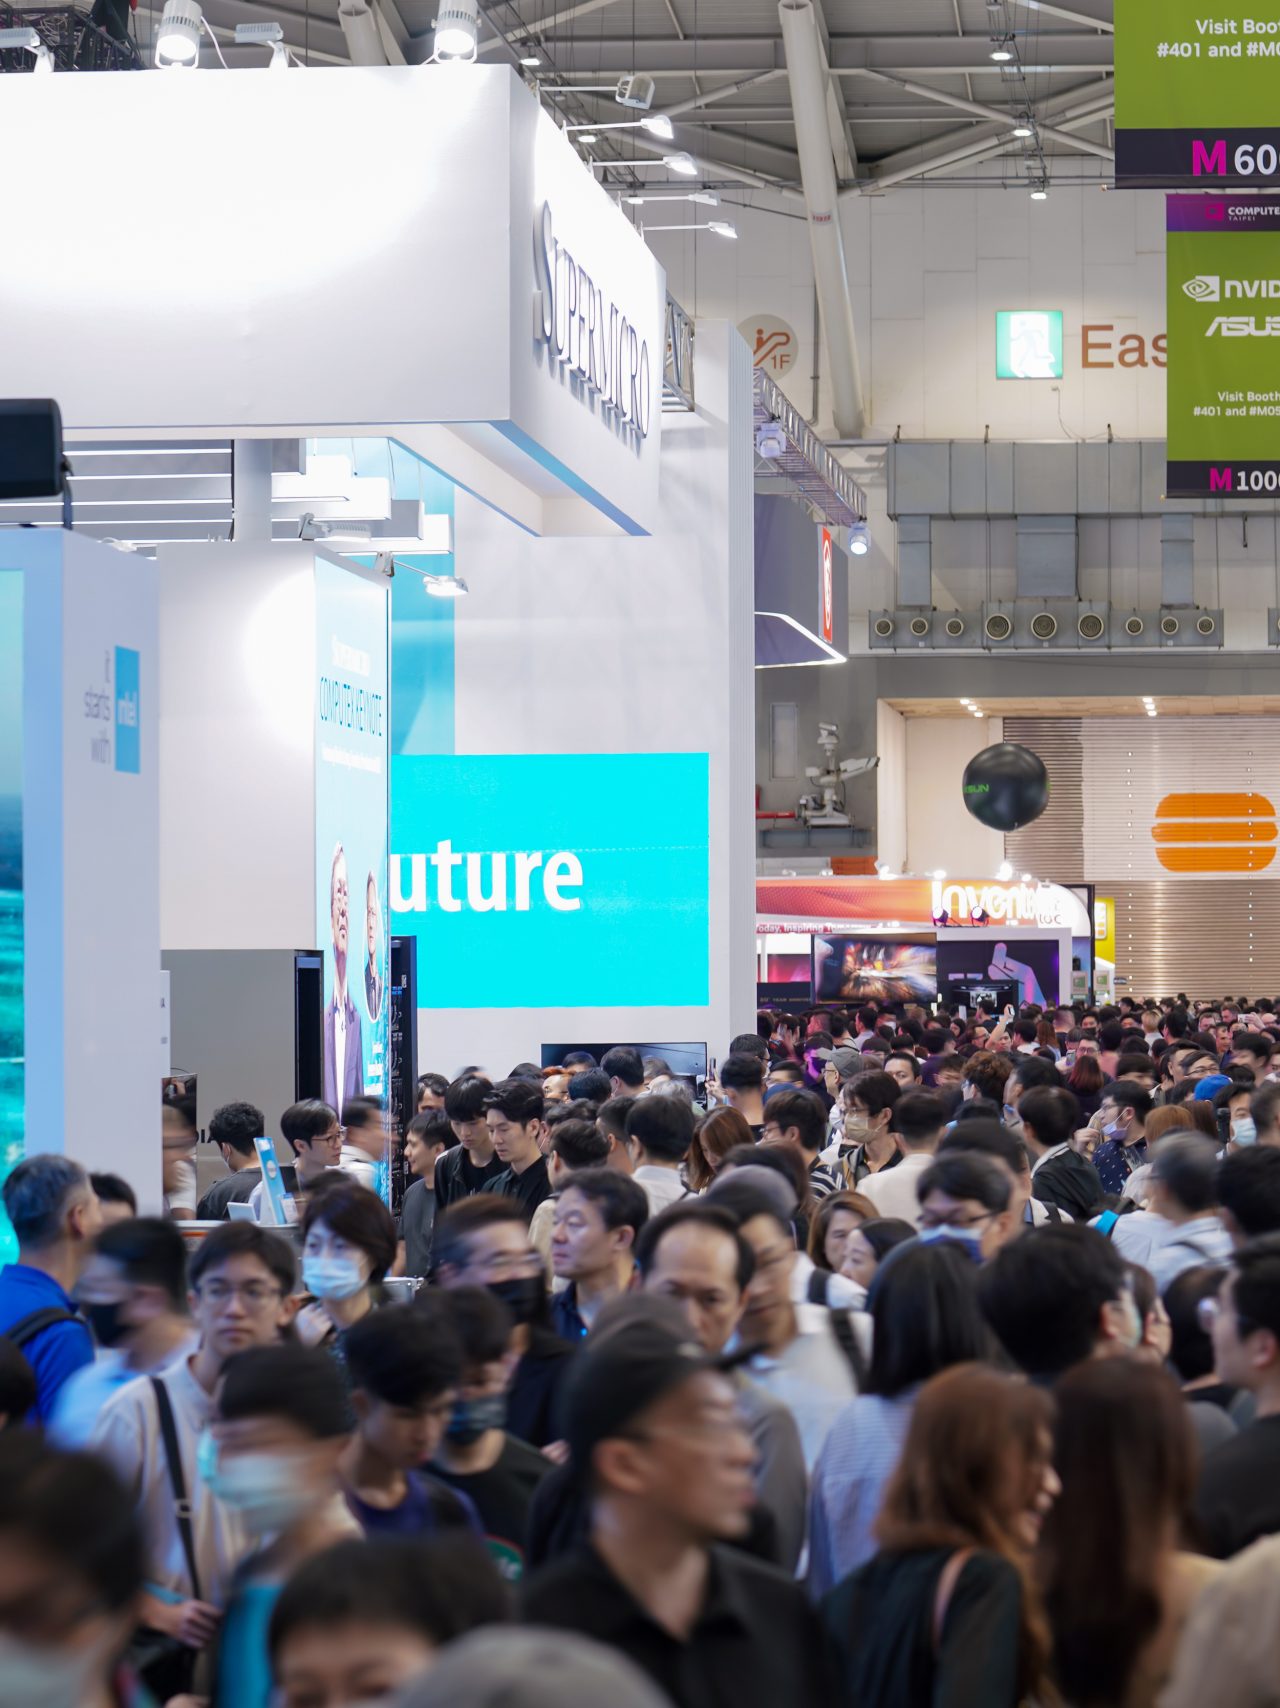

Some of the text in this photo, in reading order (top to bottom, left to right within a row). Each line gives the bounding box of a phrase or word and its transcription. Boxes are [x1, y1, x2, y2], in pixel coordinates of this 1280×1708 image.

[1196, 19, 1237, 34] Visit
[1157, 43, 1201, 57] #401
[1208, 42, 1241, 57] and
[1192, 140, 1227, 176] M
[541, 199, 650, 439] SUPERMICRO
[1082, 324, 1167, 369] Eas
[771, 354, 791, 370] 1F
[1217, 391, 1244, 402] Visit
[1193, 406, 1221, 417] #401
[1225, 406, 1246, 417] and
[1209, 467, 1232, 491] M
[390, 839, 583, 912] uture
